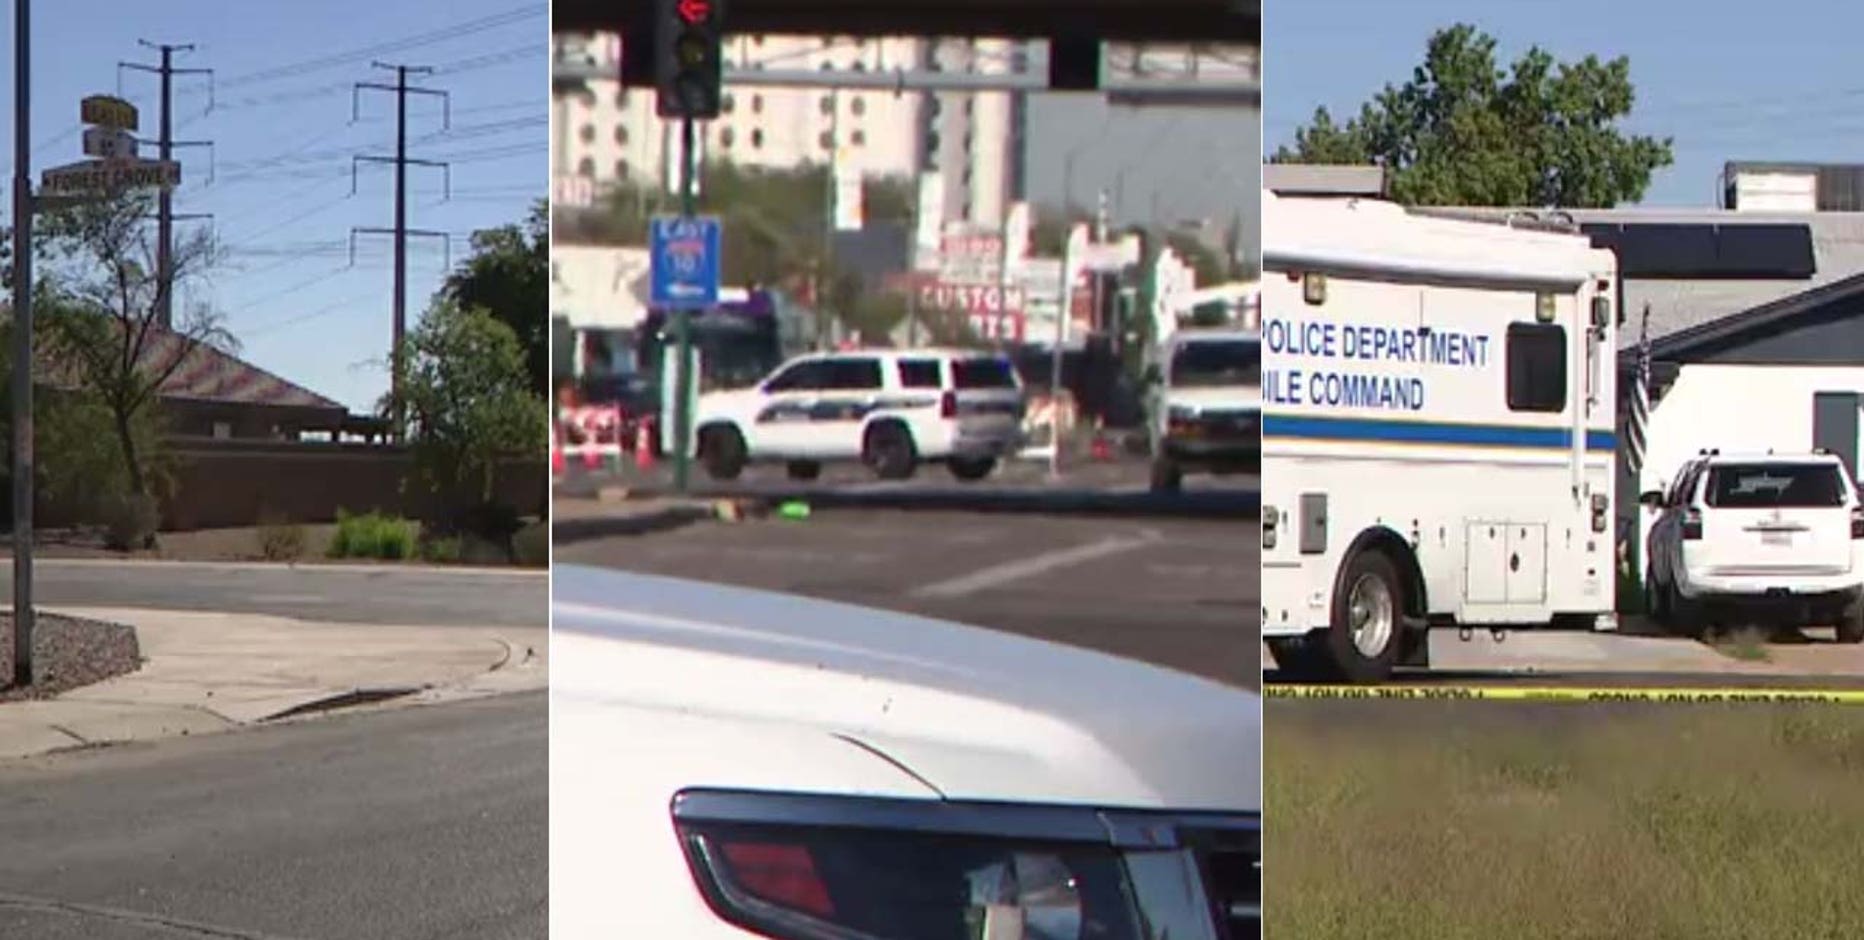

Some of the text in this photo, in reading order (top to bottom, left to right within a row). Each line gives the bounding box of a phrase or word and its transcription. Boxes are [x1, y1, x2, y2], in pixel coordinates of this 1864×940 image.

[53, 170, 109, 191] FOREST
[659, 221, 708, 238] EAST
[922, 285, 1022, 310] CUSTOM
[1263, 318, 1489, 367] OLICE DEPARTMENT
[1263, 369, 1424, 411] ILE COMMAND
